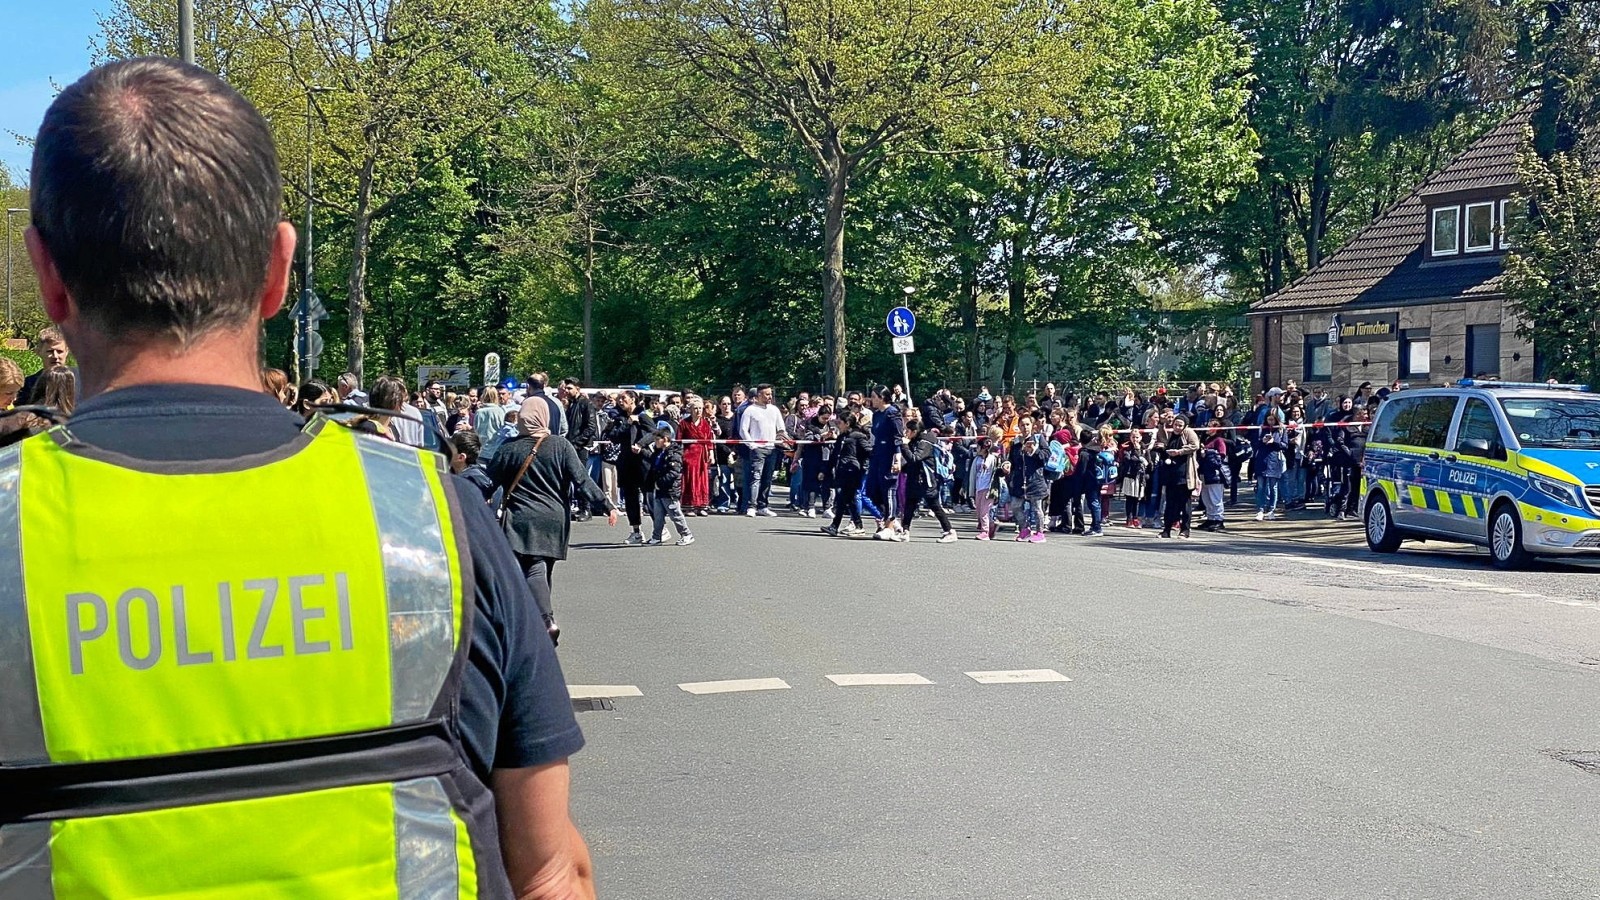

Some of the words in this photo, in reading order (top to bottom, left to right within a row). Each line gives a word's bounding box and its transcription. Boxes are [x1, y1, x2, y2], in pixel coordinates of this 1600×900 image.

[1340, 323, 1355, 337] Zum
[1356, 320, 1390, 336] Türmchen
[1448, 469, 1477, 485] POLIZEI
[65, 572, 353, 675] POLIZEI
